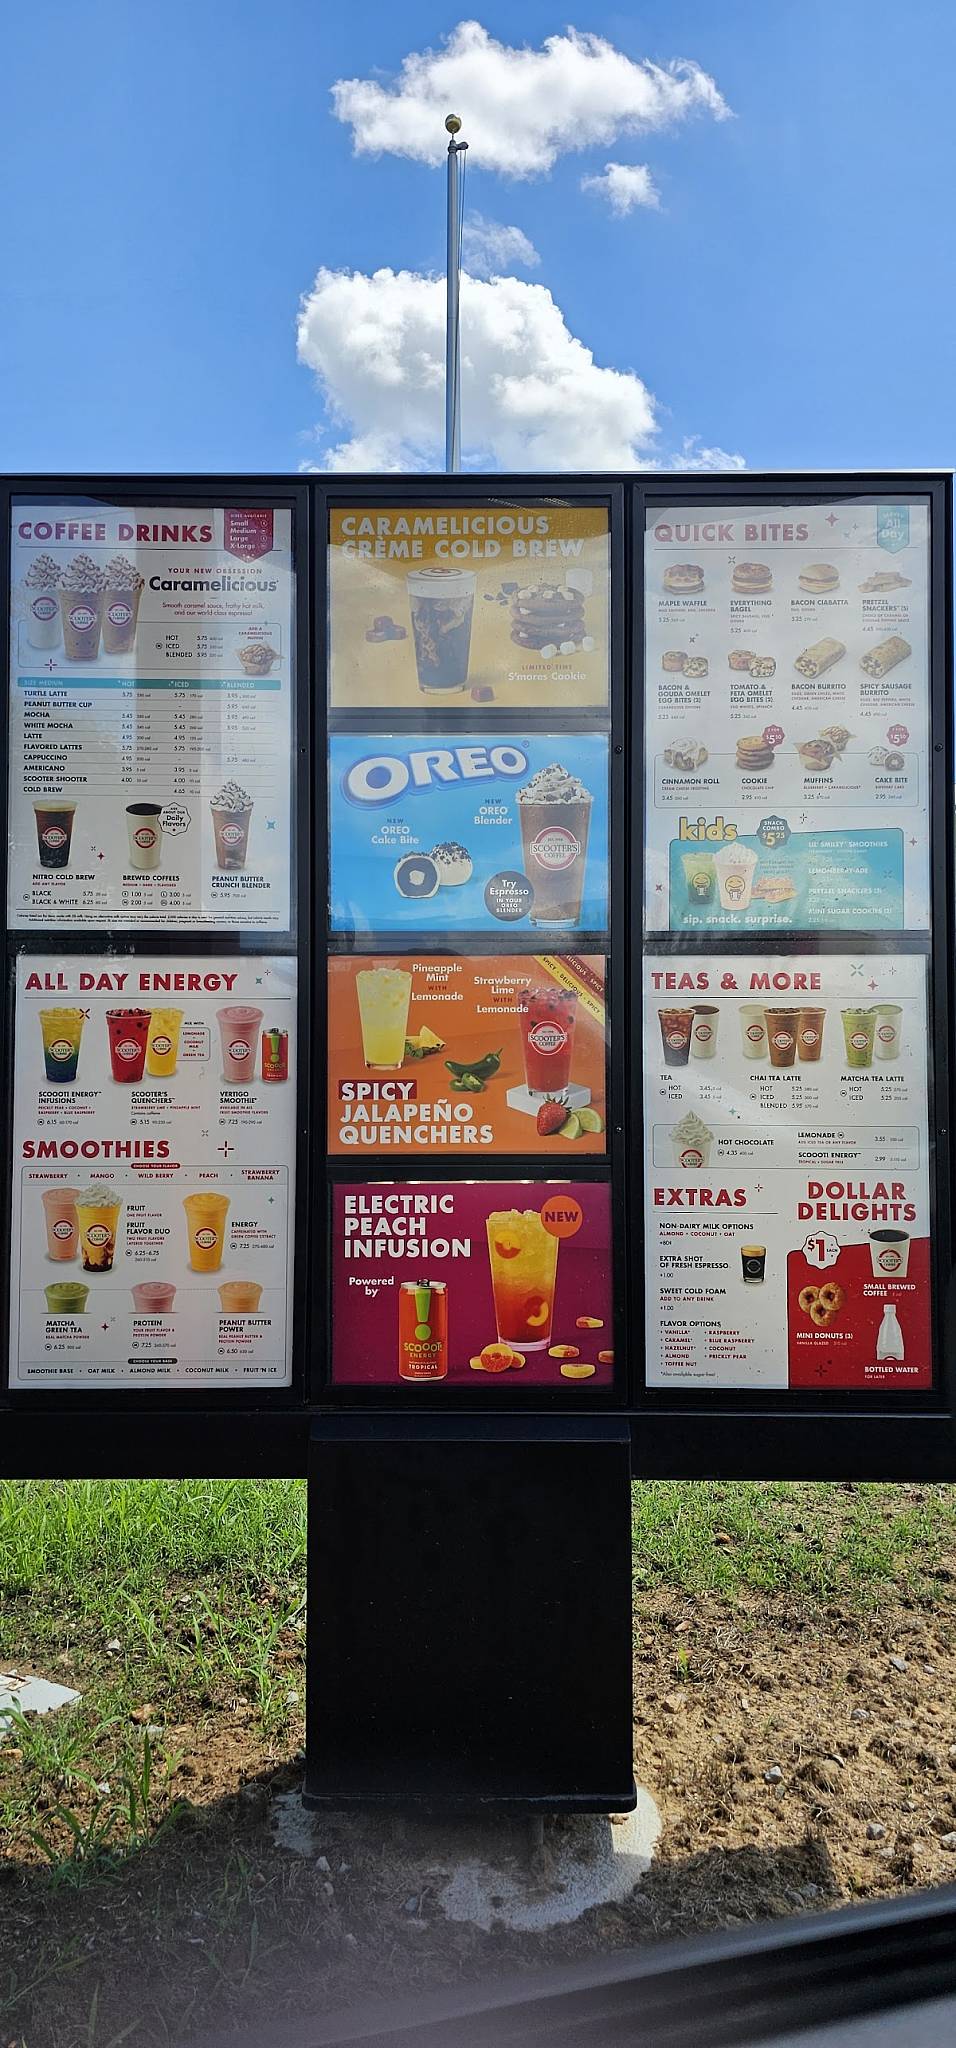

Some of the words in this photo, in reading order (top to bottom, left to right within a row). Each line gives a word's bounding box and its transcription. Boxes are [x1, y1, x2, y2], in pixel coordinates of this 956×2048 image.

[341, 516, 549, 536] CARAMELICIOUS
[886, 520, 899, 528] All
[18, 522, 106, 542] COFFEE
[118, 524, 213, 543] DRINKS
[654, 524, 734, 542] QUICK
[745, 524, 808, 541] BITES
[882, 531, 904, 540] Day
[230, 542, 256, 550] X-Large
[342, 536, 423, 559] CRÈME
[435, 540, 501, 559] COLD
[512, 539, 585, 558] BREW
[508, 672, 547, 681] S'mores
[551, 672, 586, 681] Cookie
[348, 747, 527, 800] OREO
[479, 806, 508, 815] OREO
[474, 816, 513, 825] Blender
[381, 826, 410, 835] OREO
[679, 816, 737, 842] kids
[371, 835, 397, 845] Cake
[400, 835, 420, 844] Bite
[532, 844, 578, 853] SCOOTER'S
[501, 879, 516, 889] Try
[490, 887, 529, 897] Espresso
[683, 914, 702, 925] sip.
[706, 914, 740, 923] snack.
[745, 915, 792, 925] surprise.
[412, 964, 462, 973] Pineapple
[25, 973, 68, 990] ALL
[80, 974, 128, 990] DAY
[140, 973, 238, 991] ENERGY
[426, 973, 449, 981] Mint
[474, 976, 532, 986] Strawberry
[652, 973, 709, 990] TEAS
[721, 973, 738, 990] &
[750, 973, 820, 990] MORE
[491, 986, 514, 994] Lime
[542, 957, 556, 971] SPICY
[559, 974, 584, 997] DELICIOUS
[586, 999, 601, 1014] SPICY
[411, 992, 463, 1001] Lemonade
[477, 1004, 529, 1013] Lemonade
[530, 1034, 566, 1042] SCOOTER'S
[341, 1083, 414, 1101] SPICY
[340, 1099, 473, 1123] JALAPEÑO
[339, 1125, 494, 1145] QUENCHERS
[23, 1141, 170, 1158] SMOOTHIES
[808, 1182, 906, 1200] DOLLAR
[654, 1188, 746, 1206] EXTRAS
[344, 1195, 454, 1214] ELECTRIC
[544, 1212, 578, 1222] NEW
[798, 1203, 916, 1221] DELIGHTS
[344, 1217, 426, 1236] PEACH
[344, 1239, 471, 1258] INFUSION
[349, 1276, 394, 1285] Powered
[365, 1287, 378, 1297] by
